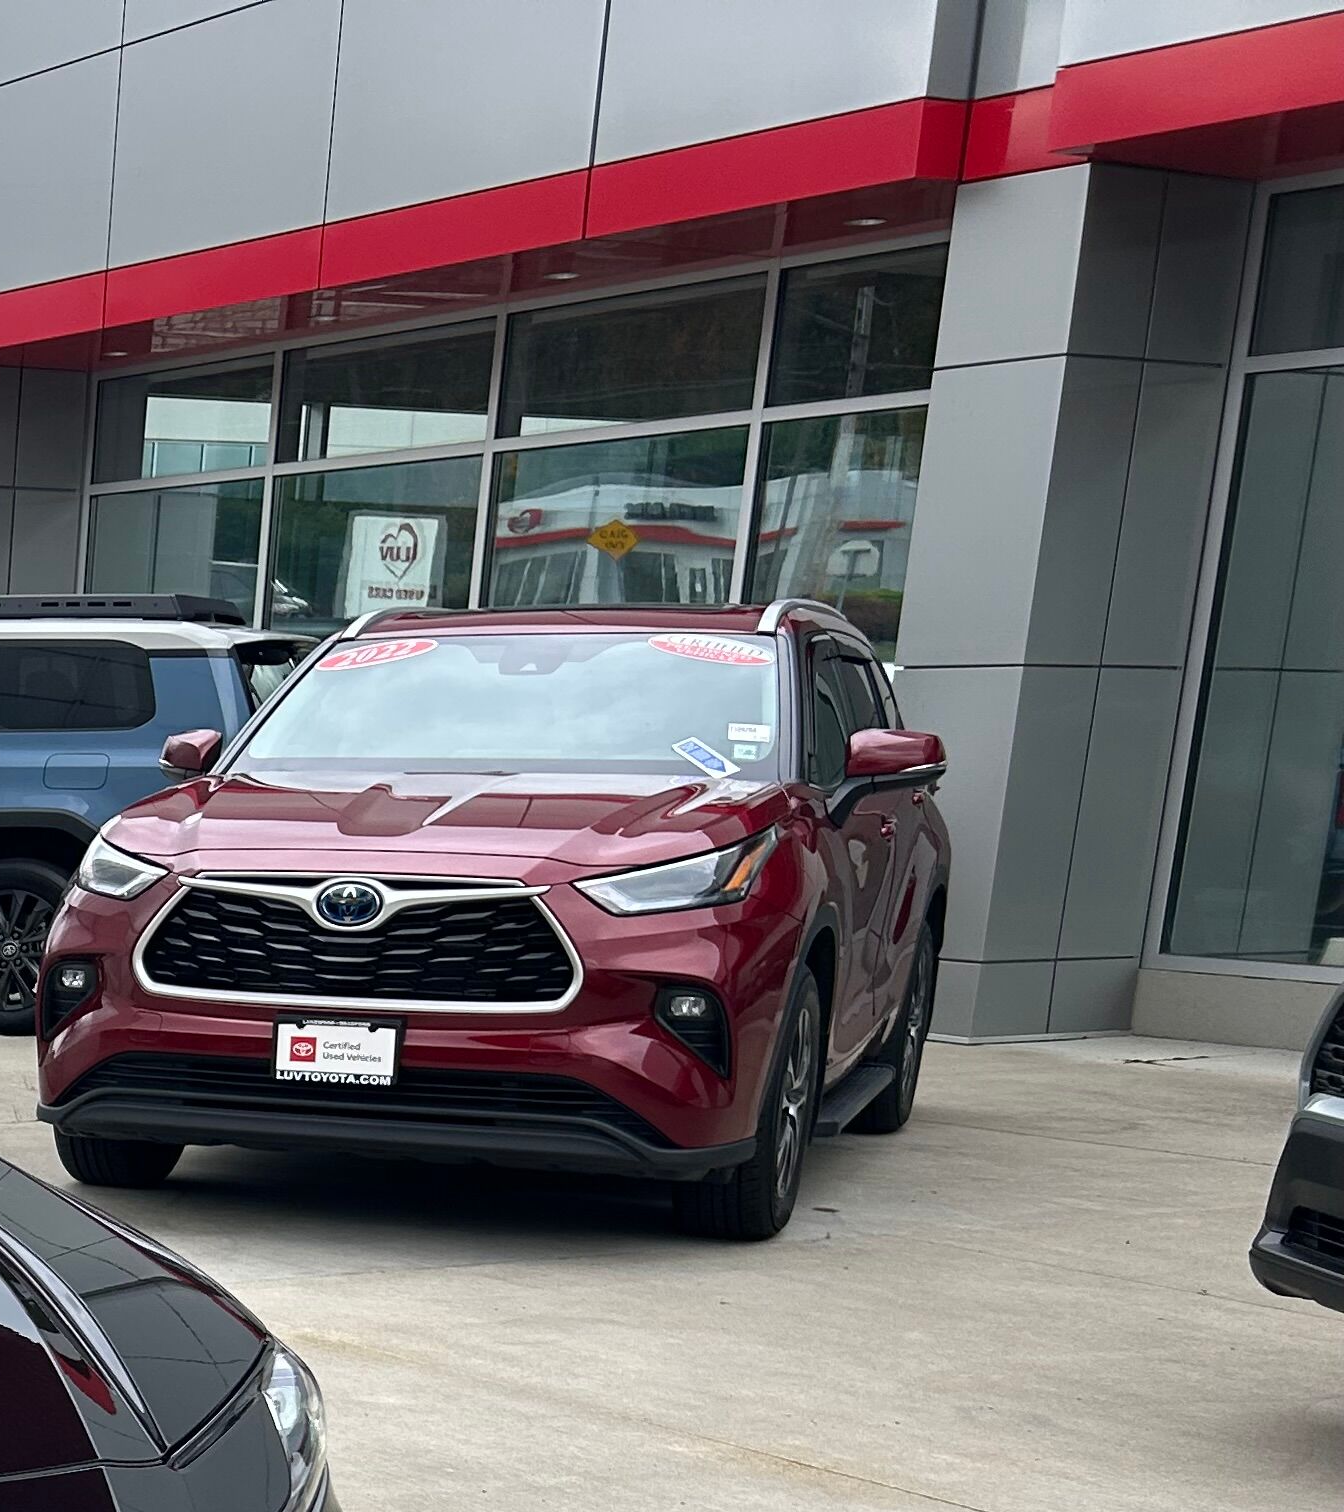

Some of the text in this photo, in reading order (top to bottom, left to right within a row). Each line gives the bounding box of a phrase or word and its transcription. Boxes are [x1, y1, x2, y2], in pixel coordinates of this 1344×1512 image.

[336, 640, 417, 667] 2022
[322, 1041, 361, 1051] Certified
[322, 1052, 382, 1063] Used Vehicles
[276, 1070, 392, 1086] LUVTOYOTA.COM
